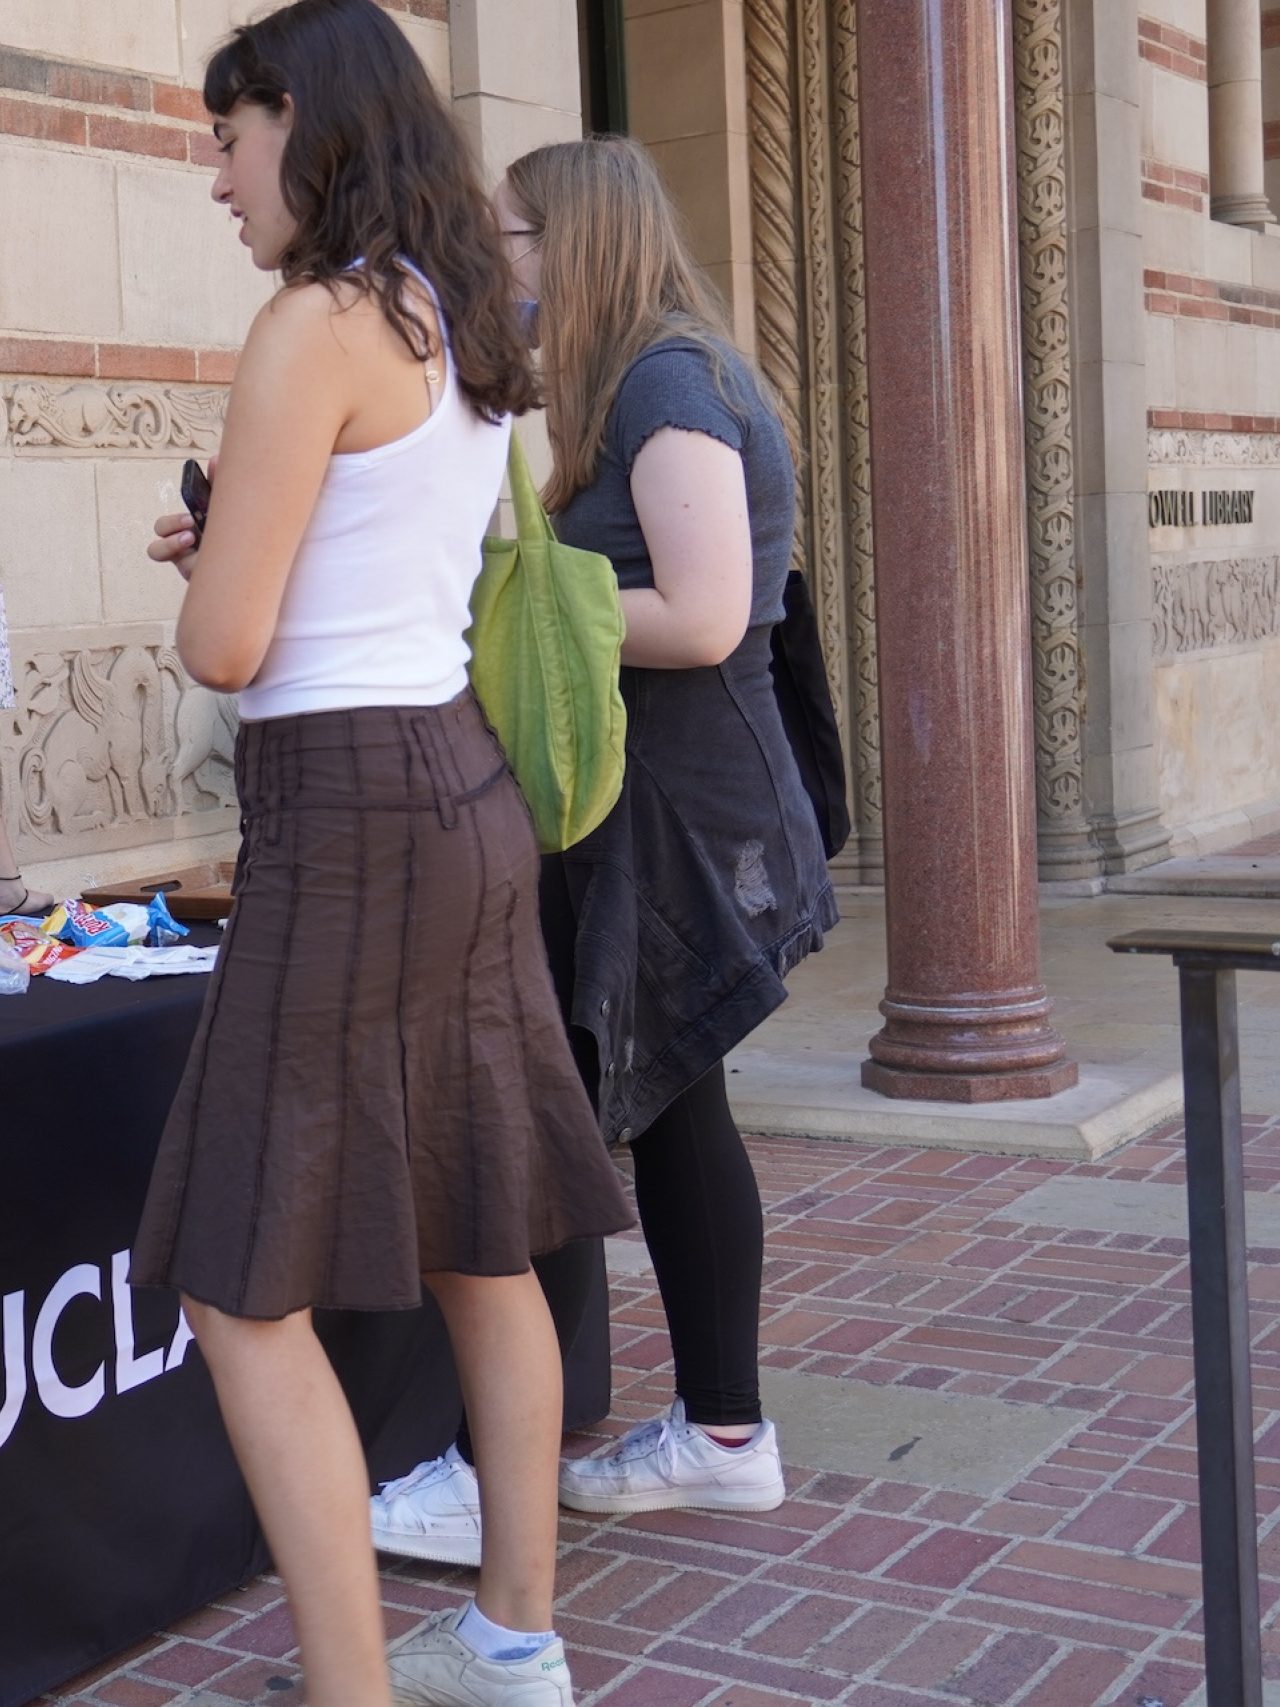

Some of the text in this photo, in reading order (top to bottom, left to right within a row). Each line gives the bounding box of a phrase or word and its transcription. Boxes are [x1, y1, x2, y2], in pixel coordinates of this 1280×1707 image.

[1148, 490, 1255, 528] OWELL LIBRARY
[541, 1657, 566, 1672] Ree
